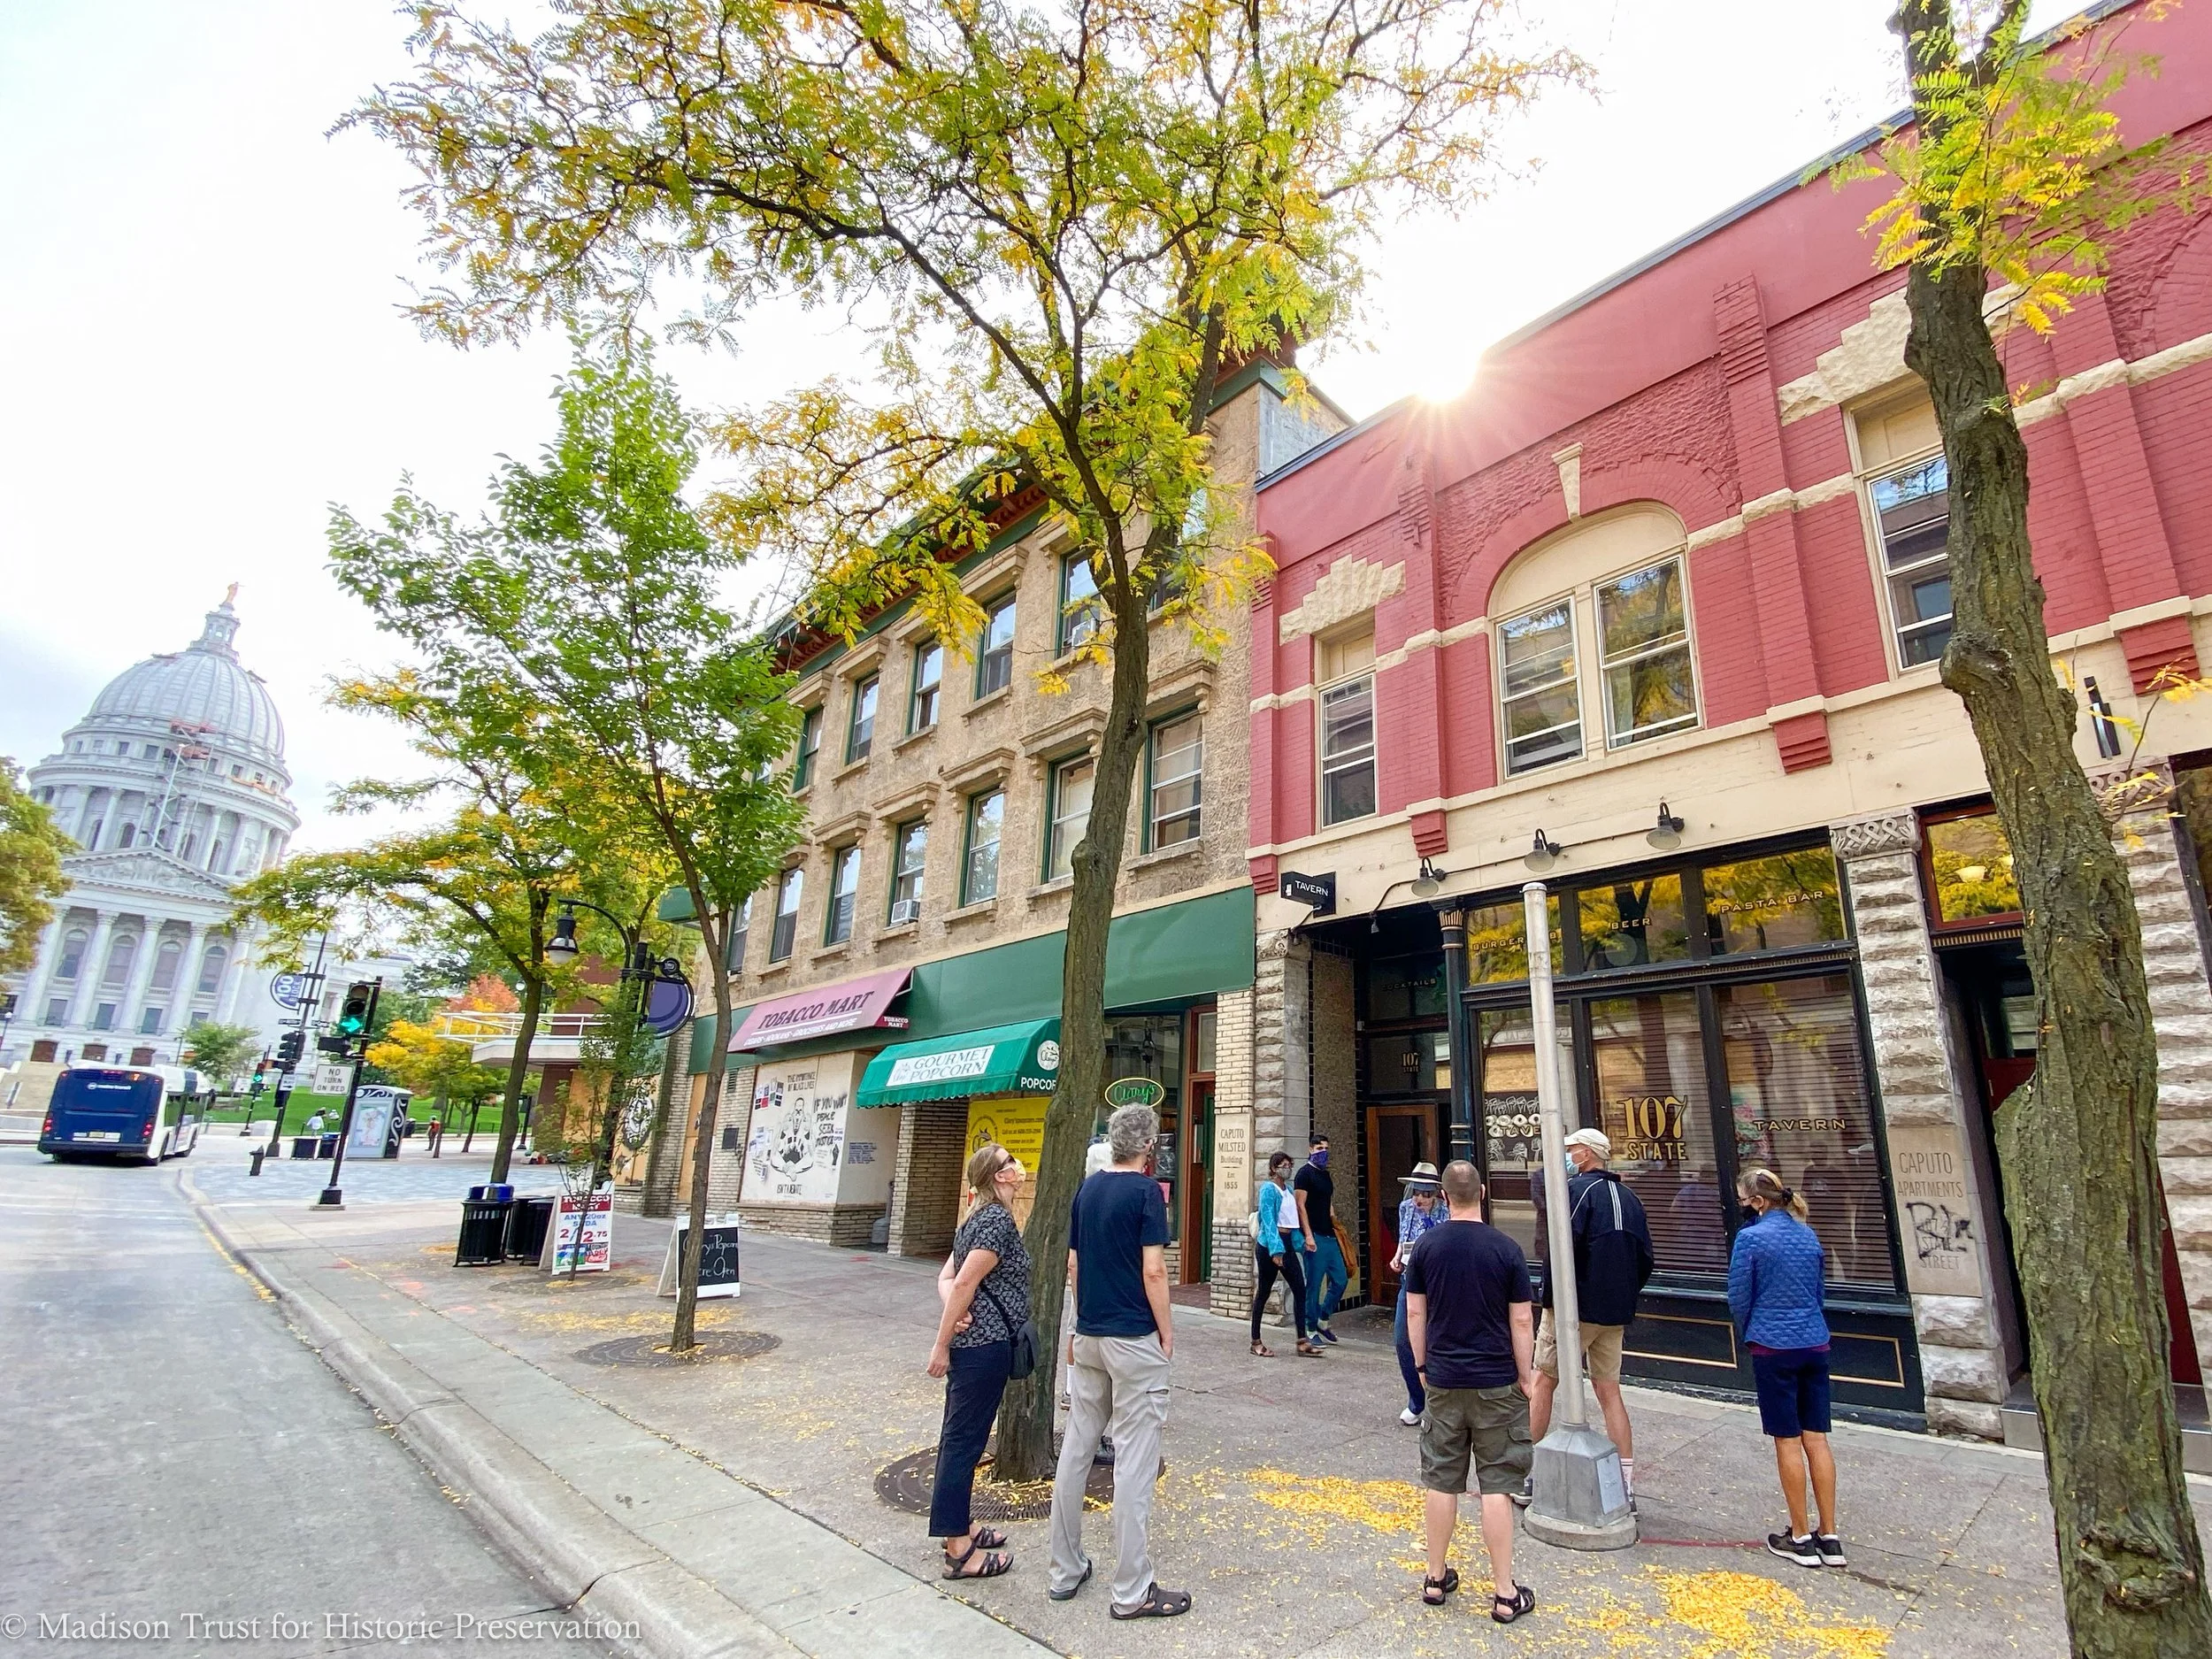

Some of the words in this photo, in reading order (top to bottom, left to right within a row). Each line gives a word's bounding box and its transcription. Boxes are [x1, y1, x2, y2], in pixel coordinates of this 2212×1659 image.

[1294, 879, 1329, 897] TAVERN
[1721, 898, 1778, 913] PASTA
[1787, 890, 1824, 903] BAR
[1611, 918, 1651, 930] BEER
[1472, 936, 1525, 951] BURGER
[757, 1002, 825, 1030] TOBACCO
[823, 991, 874, 1017] MART
[914, 1048, 993, 1070] GOURMET
[1402, 1053, 1420, 1066] 107
[910, 1061, 987, 1082] POPCORN
[1020, 1077, 1056, 1090] POPCOR
[1616, 1094, 1688, 1141] 107
[1753, 1118, 1847, 1131] TAVERN
[1220, 1128, 1244, 1139] CAPUTO
[1502, 1125, 1542, 1135] TAVE
[1218, 1141, 1246, 1152] MILSTED
[1628, 1141, 1688, 1160] STATE
[1220, 1156, 1243, 1165] Building
[1899, 1152, 1953, 1174] CAPUTO
[1898, 1181, 1963, 1198] APARTMENTS
[713, 1256, 735, 1279] Open
[1920, 1255, 1960, 1270] STREET
